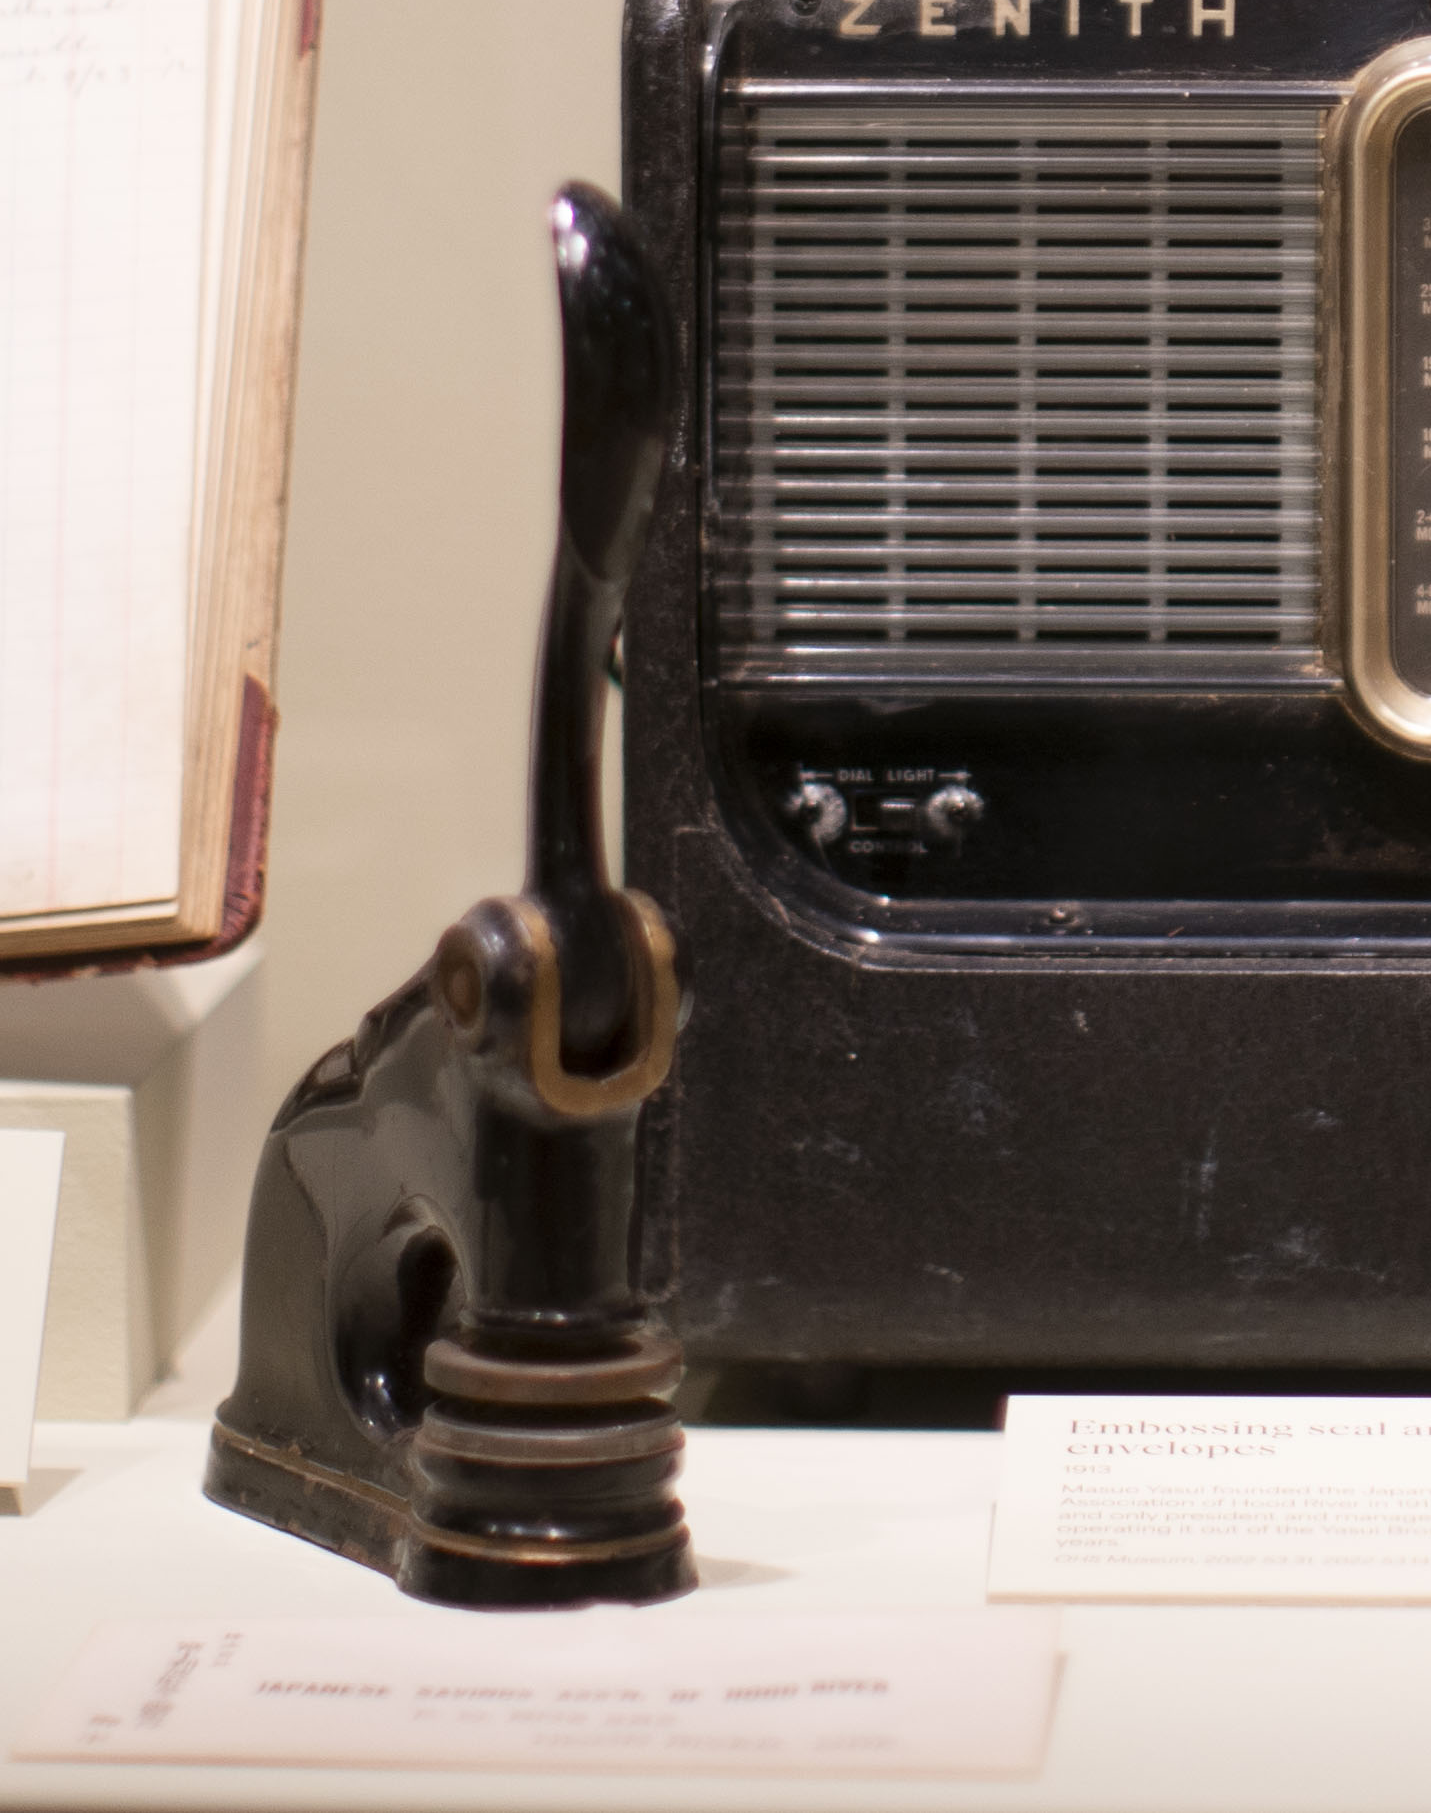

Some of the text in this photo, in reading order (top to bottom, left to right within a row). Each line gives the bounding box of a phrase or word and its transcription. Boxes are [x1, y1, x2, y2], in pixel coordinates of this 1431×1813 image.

[838, 769, 935, 782] DIAL LIGHT
[1068, 1419, 1293, 1439] Embossing
[1308, 1419, 1386, 1437] seal
[1066, 1440, 1278, 1459] envelopes
[1064, 1464, 1112, 1475] 1913
